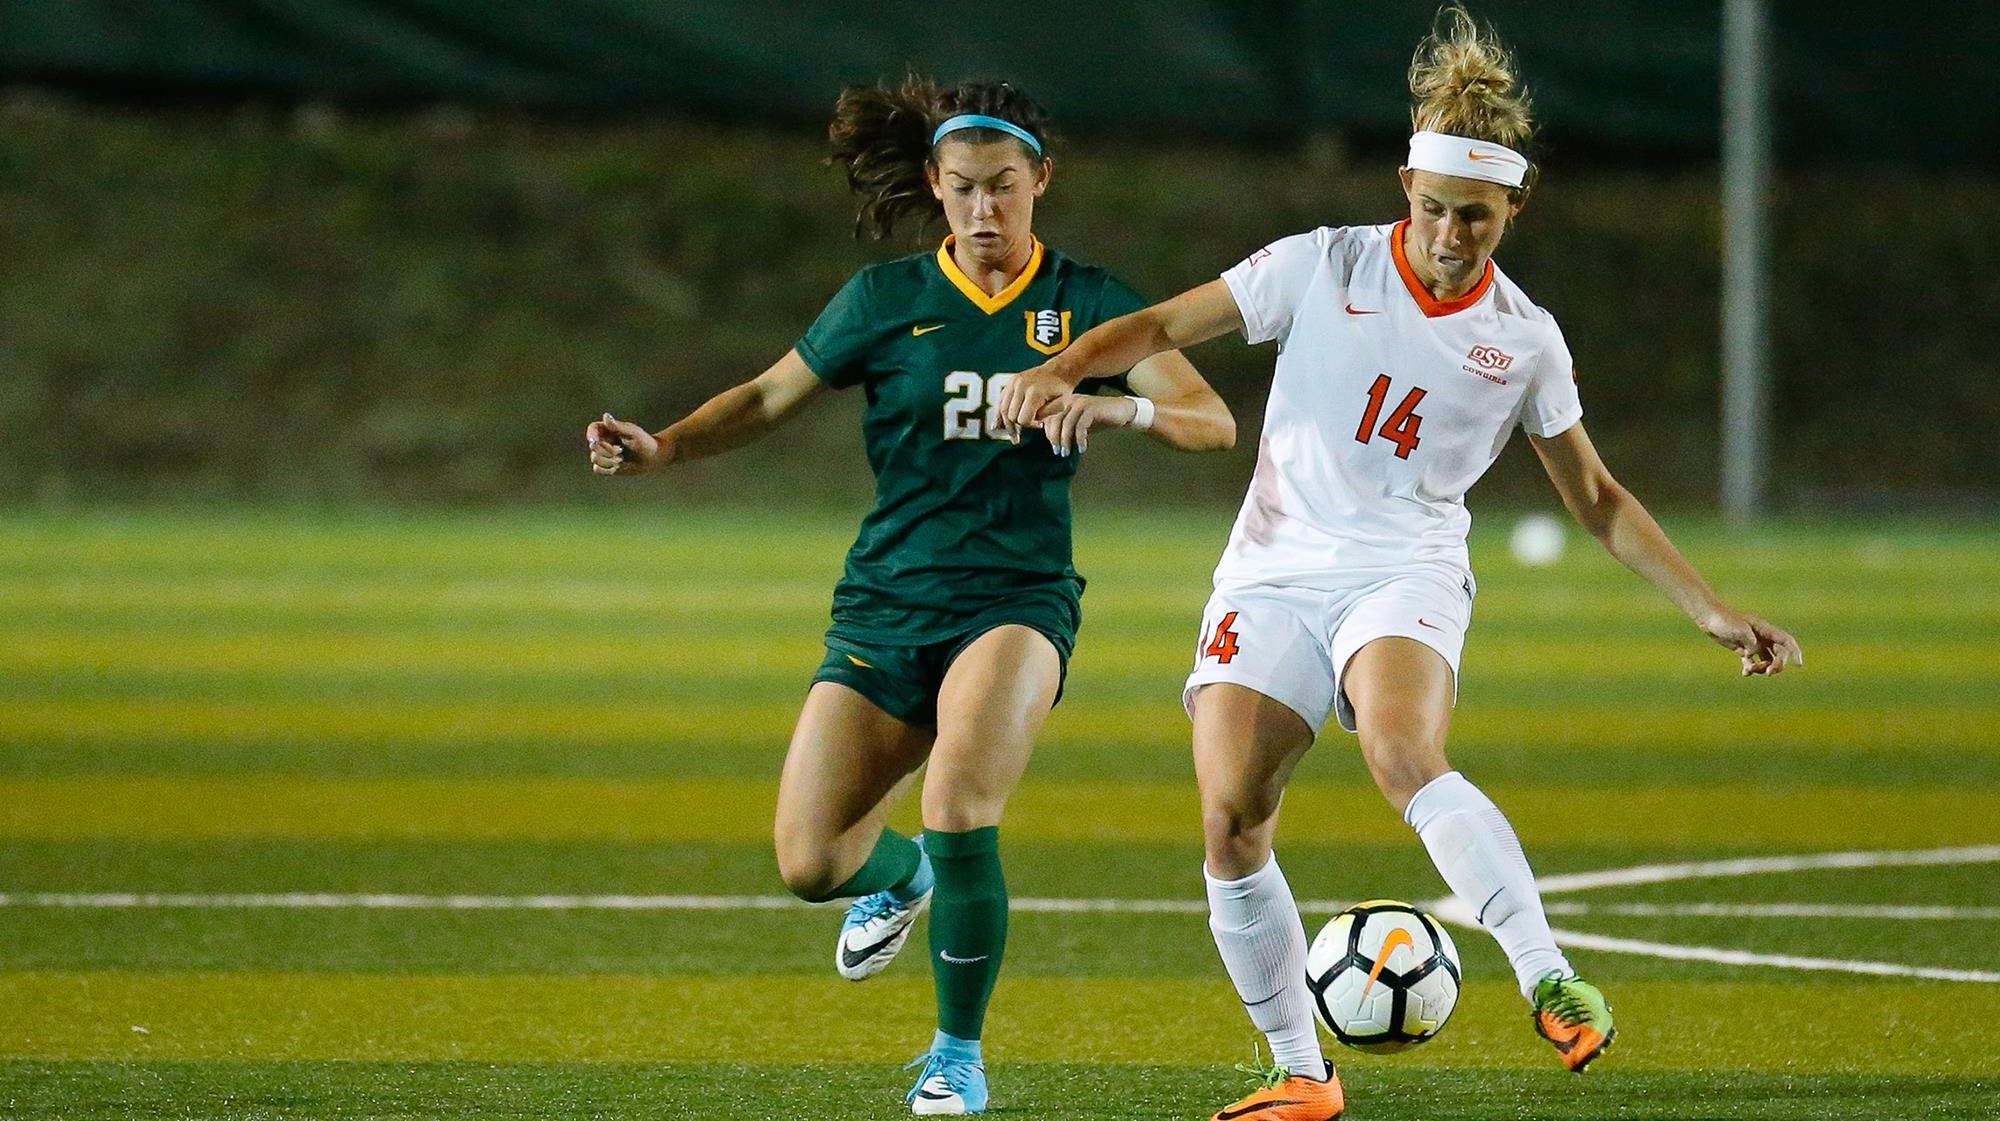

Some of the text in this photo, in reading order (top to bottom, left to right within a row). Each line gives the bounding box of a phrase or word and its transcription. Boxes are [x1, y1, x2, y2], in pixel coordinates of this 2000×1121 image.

[1467, 345, 1513, 370] OSU
[1462, 364, 1507, 386] COWGIRLS
[1355, 373, 1428, 460] 14
